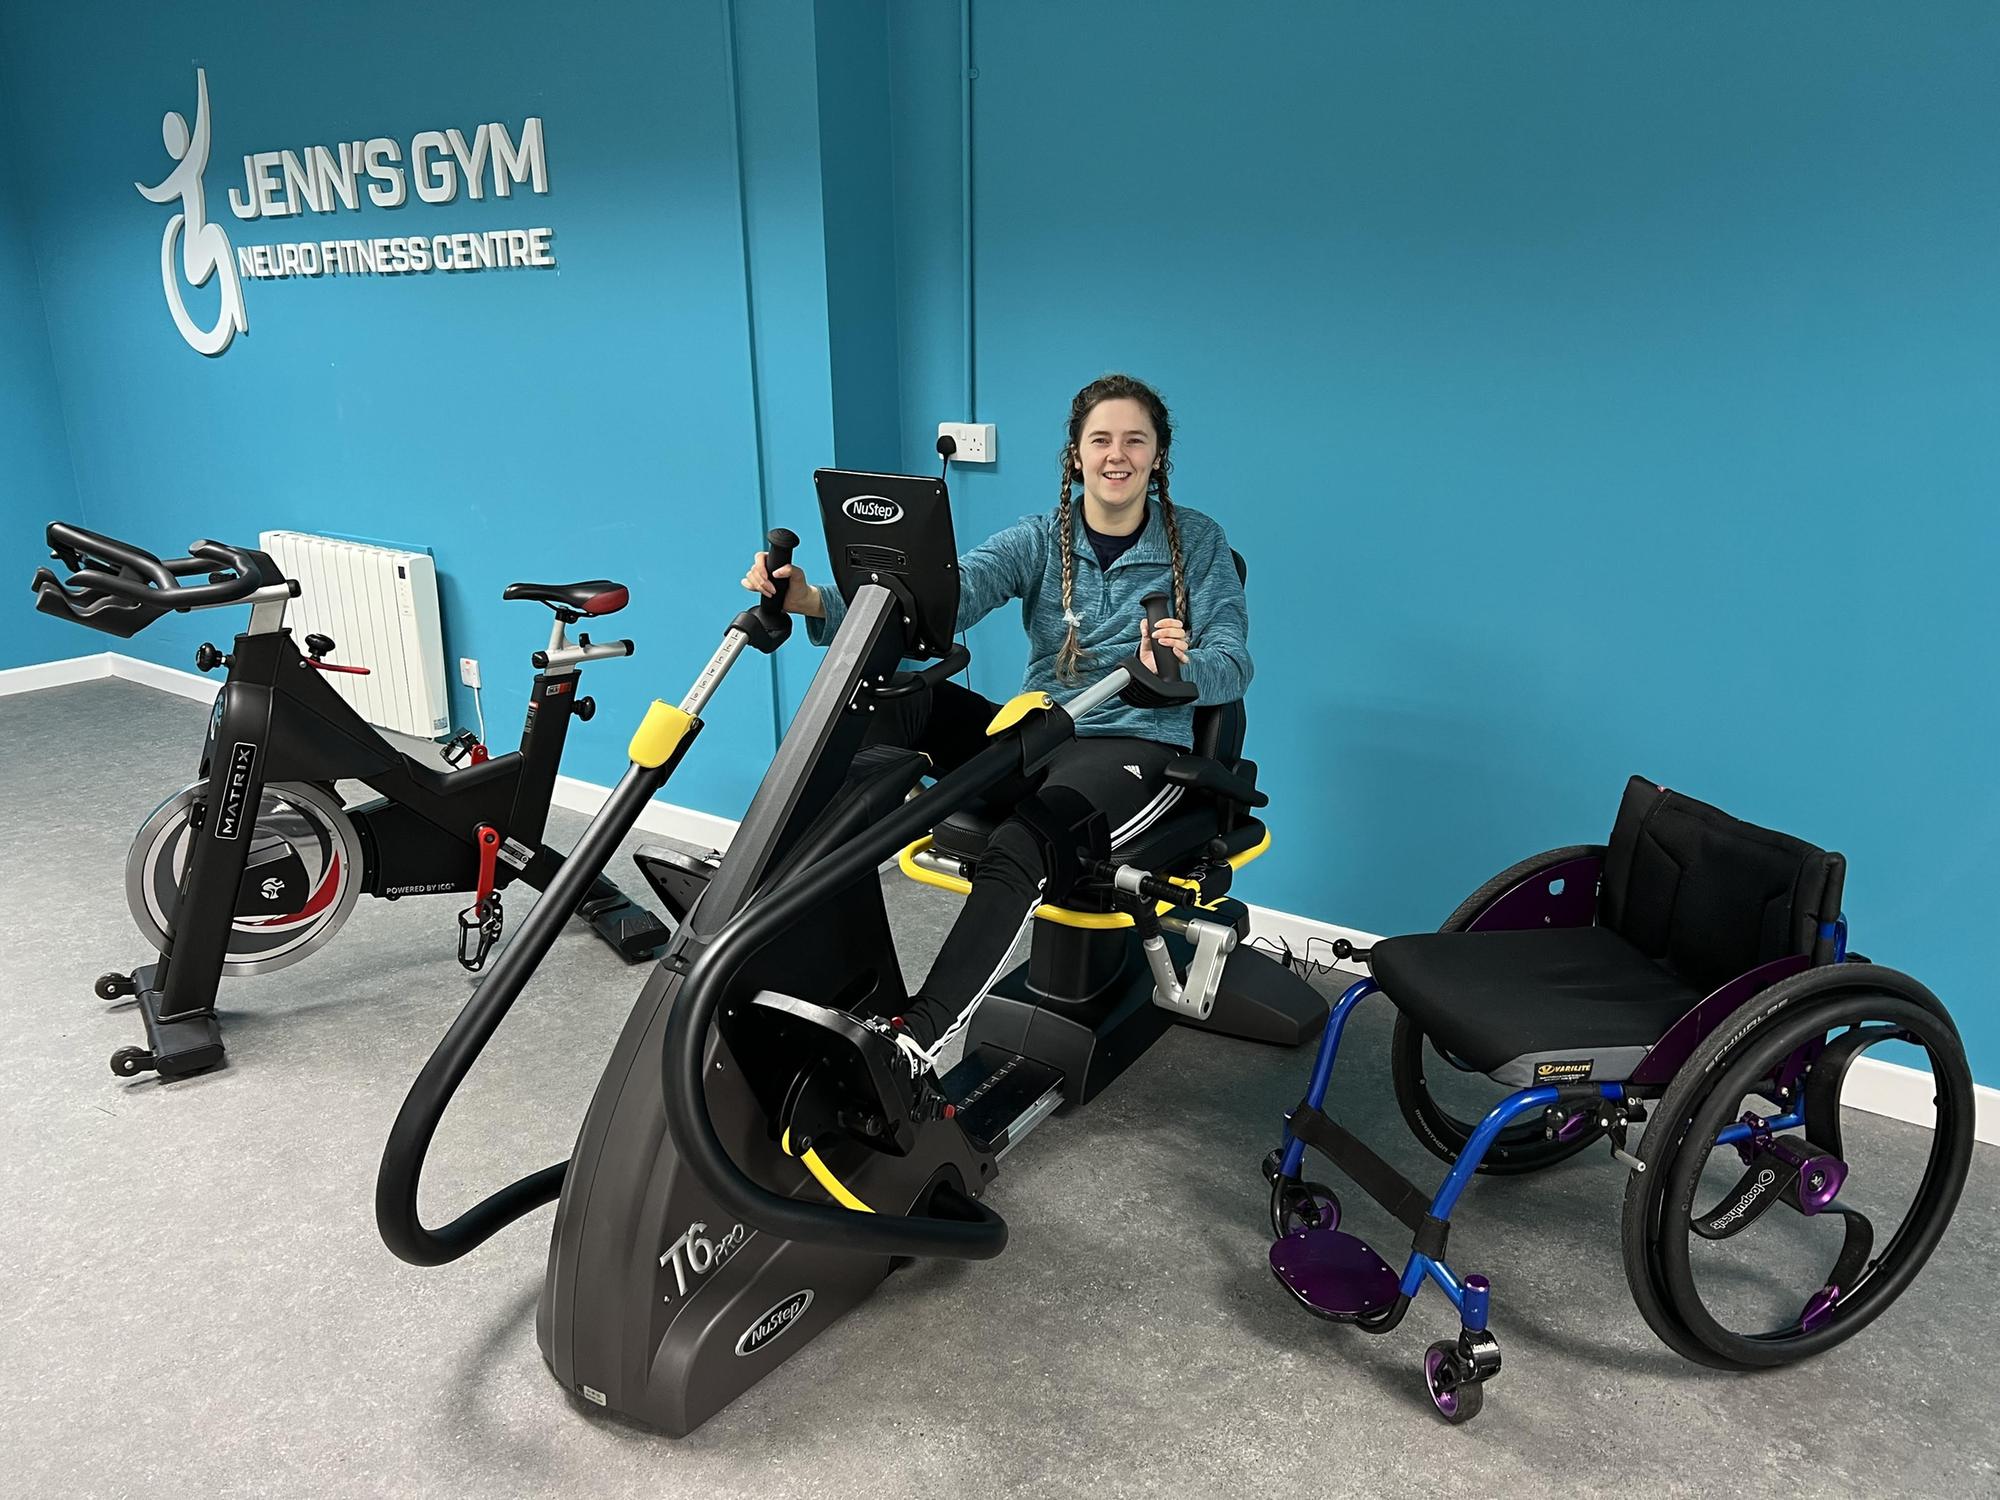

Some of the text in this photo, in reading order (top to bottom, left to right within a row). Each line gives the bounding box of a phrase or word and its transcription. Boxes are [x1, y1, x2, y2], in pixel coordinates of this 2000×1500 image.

[228, 117, 548, 218] JENN'S GYM
[237, 227, 555, 277] NEURO FITNESS CENTRE
[222, 748, 251, 834] MATRIX
[386, 885, 425, 895] POWERED
[426, 884, 437, 892] BY
[1553, 1064, 1592, 1073] VARILITE
[659, 1221, 744, 1297] T6 PRO
